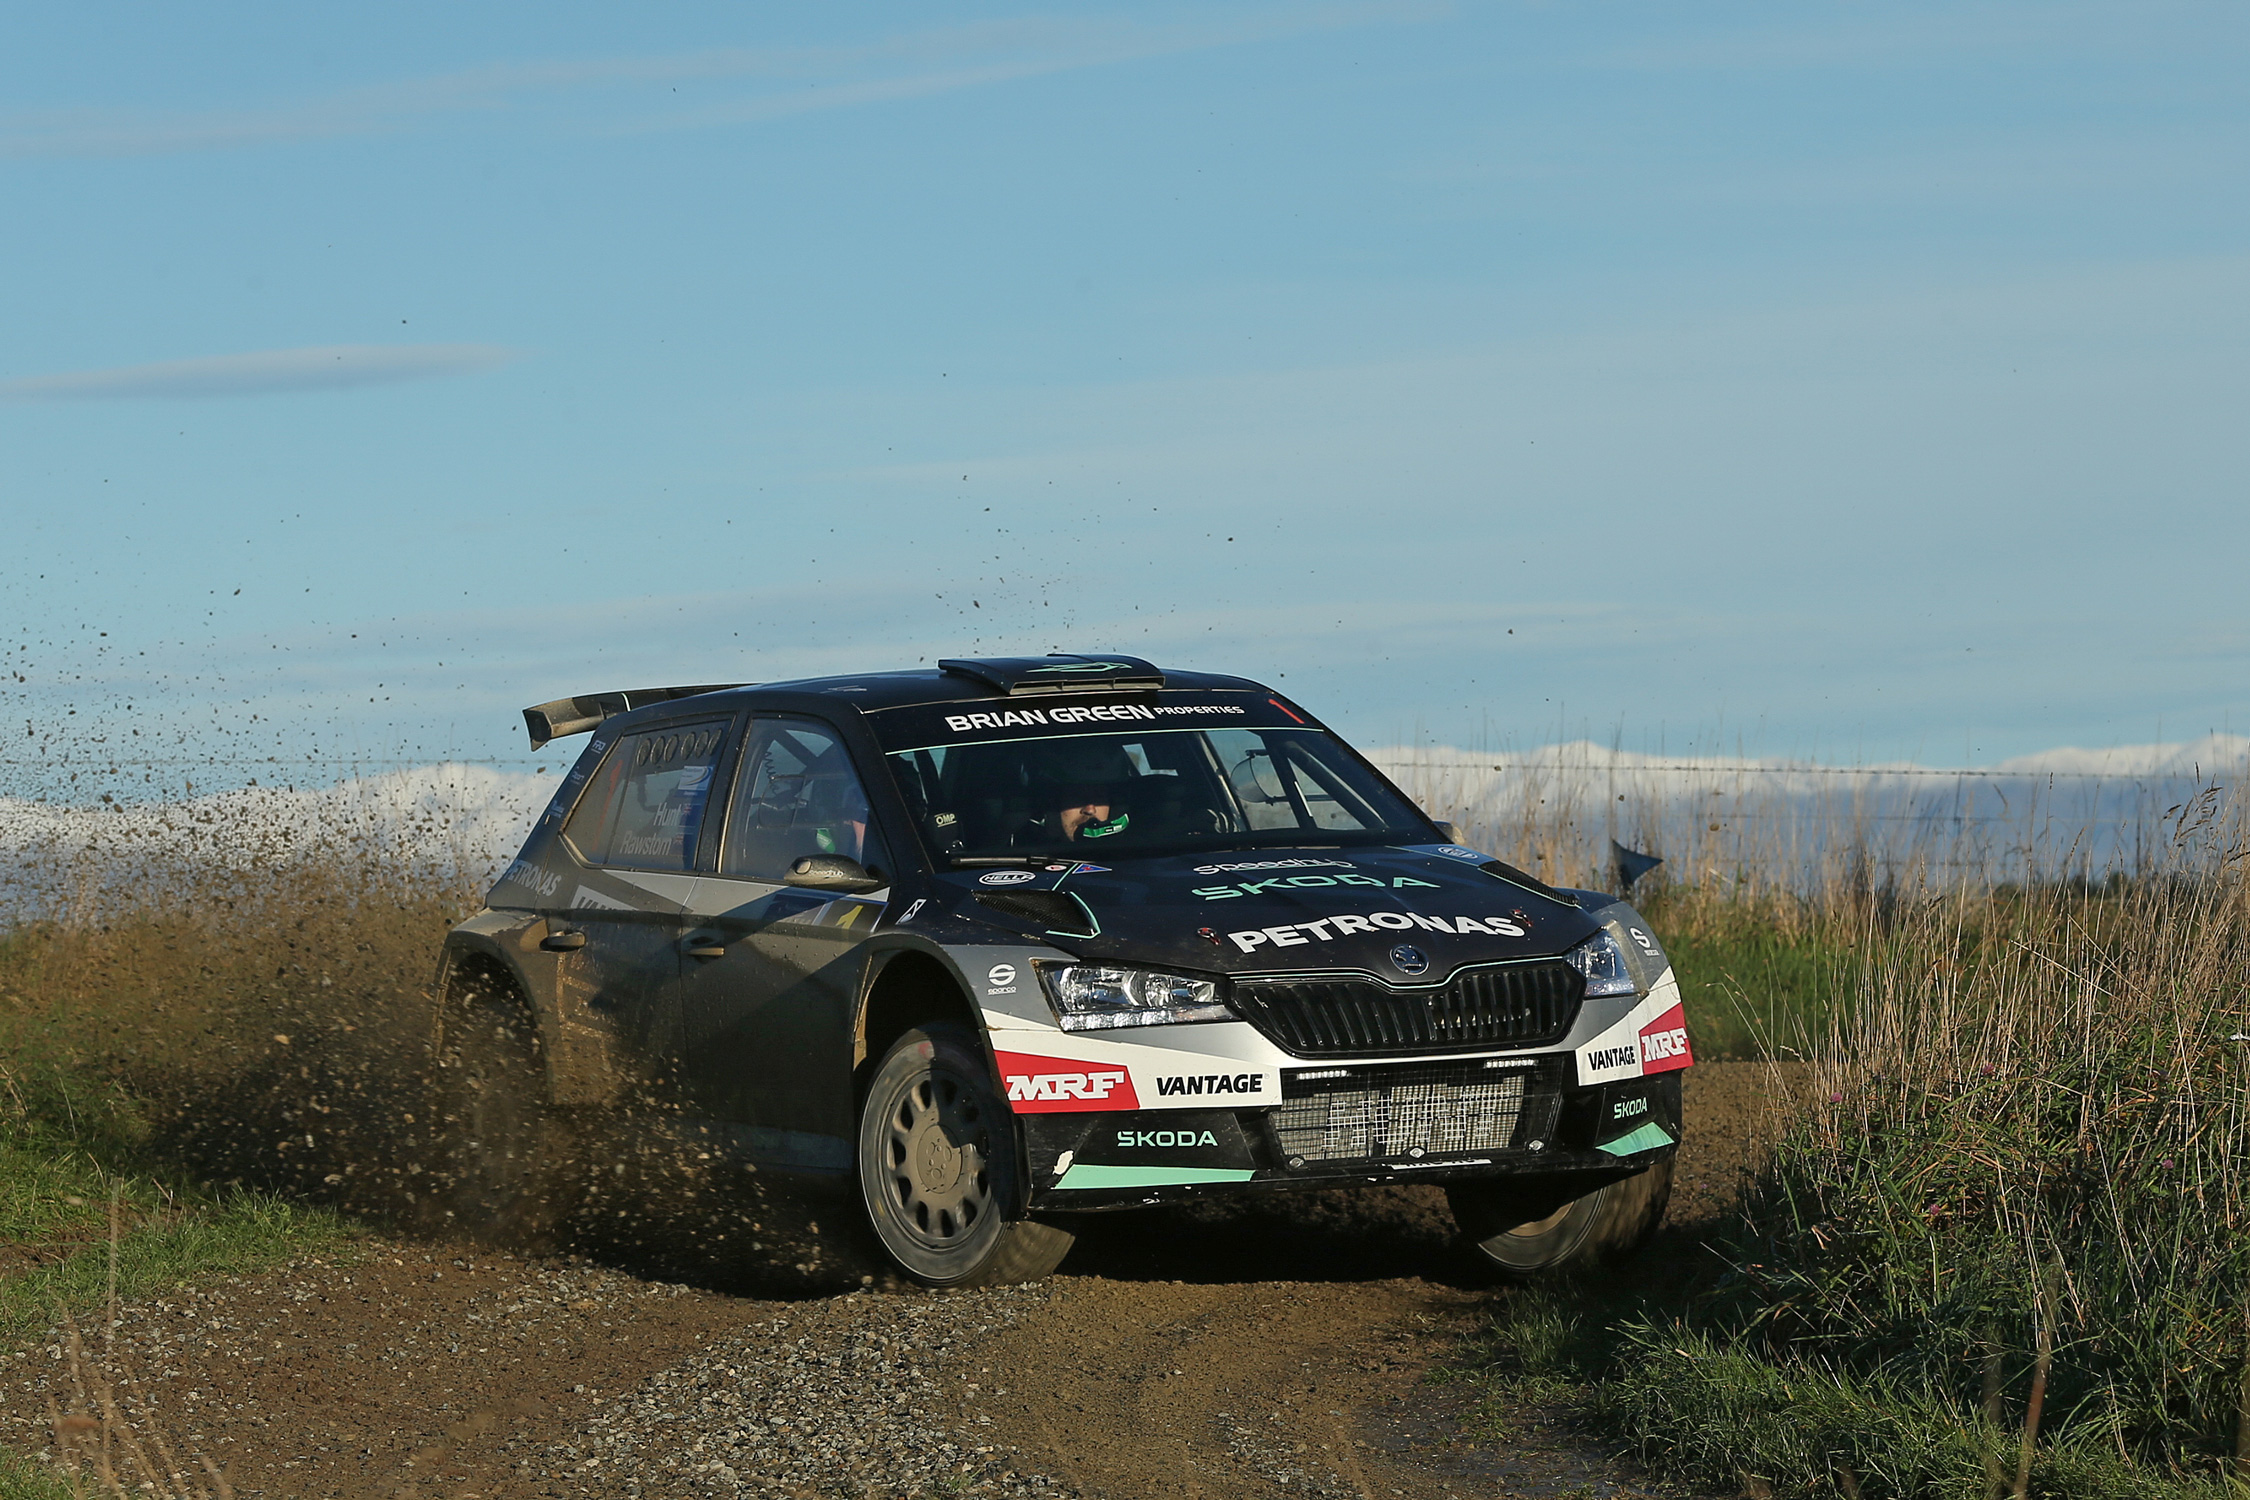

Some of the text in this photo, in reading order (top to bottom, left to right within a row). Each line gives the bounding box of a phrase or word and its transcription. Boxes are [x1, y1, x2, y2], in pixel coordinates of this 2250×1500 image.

[944, 704, 1245, 732] BRIAN GREEN PROPERTIES
[653, 802, 683, 826] Hunt
[936, 813, 955, 825] OMP
[982, 872, 1034, 883] HELLA
[1227, 912, 1526, 954] PETRONAS
[1640, 1027, 1689, 1062] MRF
[1587, 1046, 1636, 1071] VANTAGE
[1006, 1071, 1124, 1101] MRF
[1156, 1073, 1264, 1096] VANTAGE
